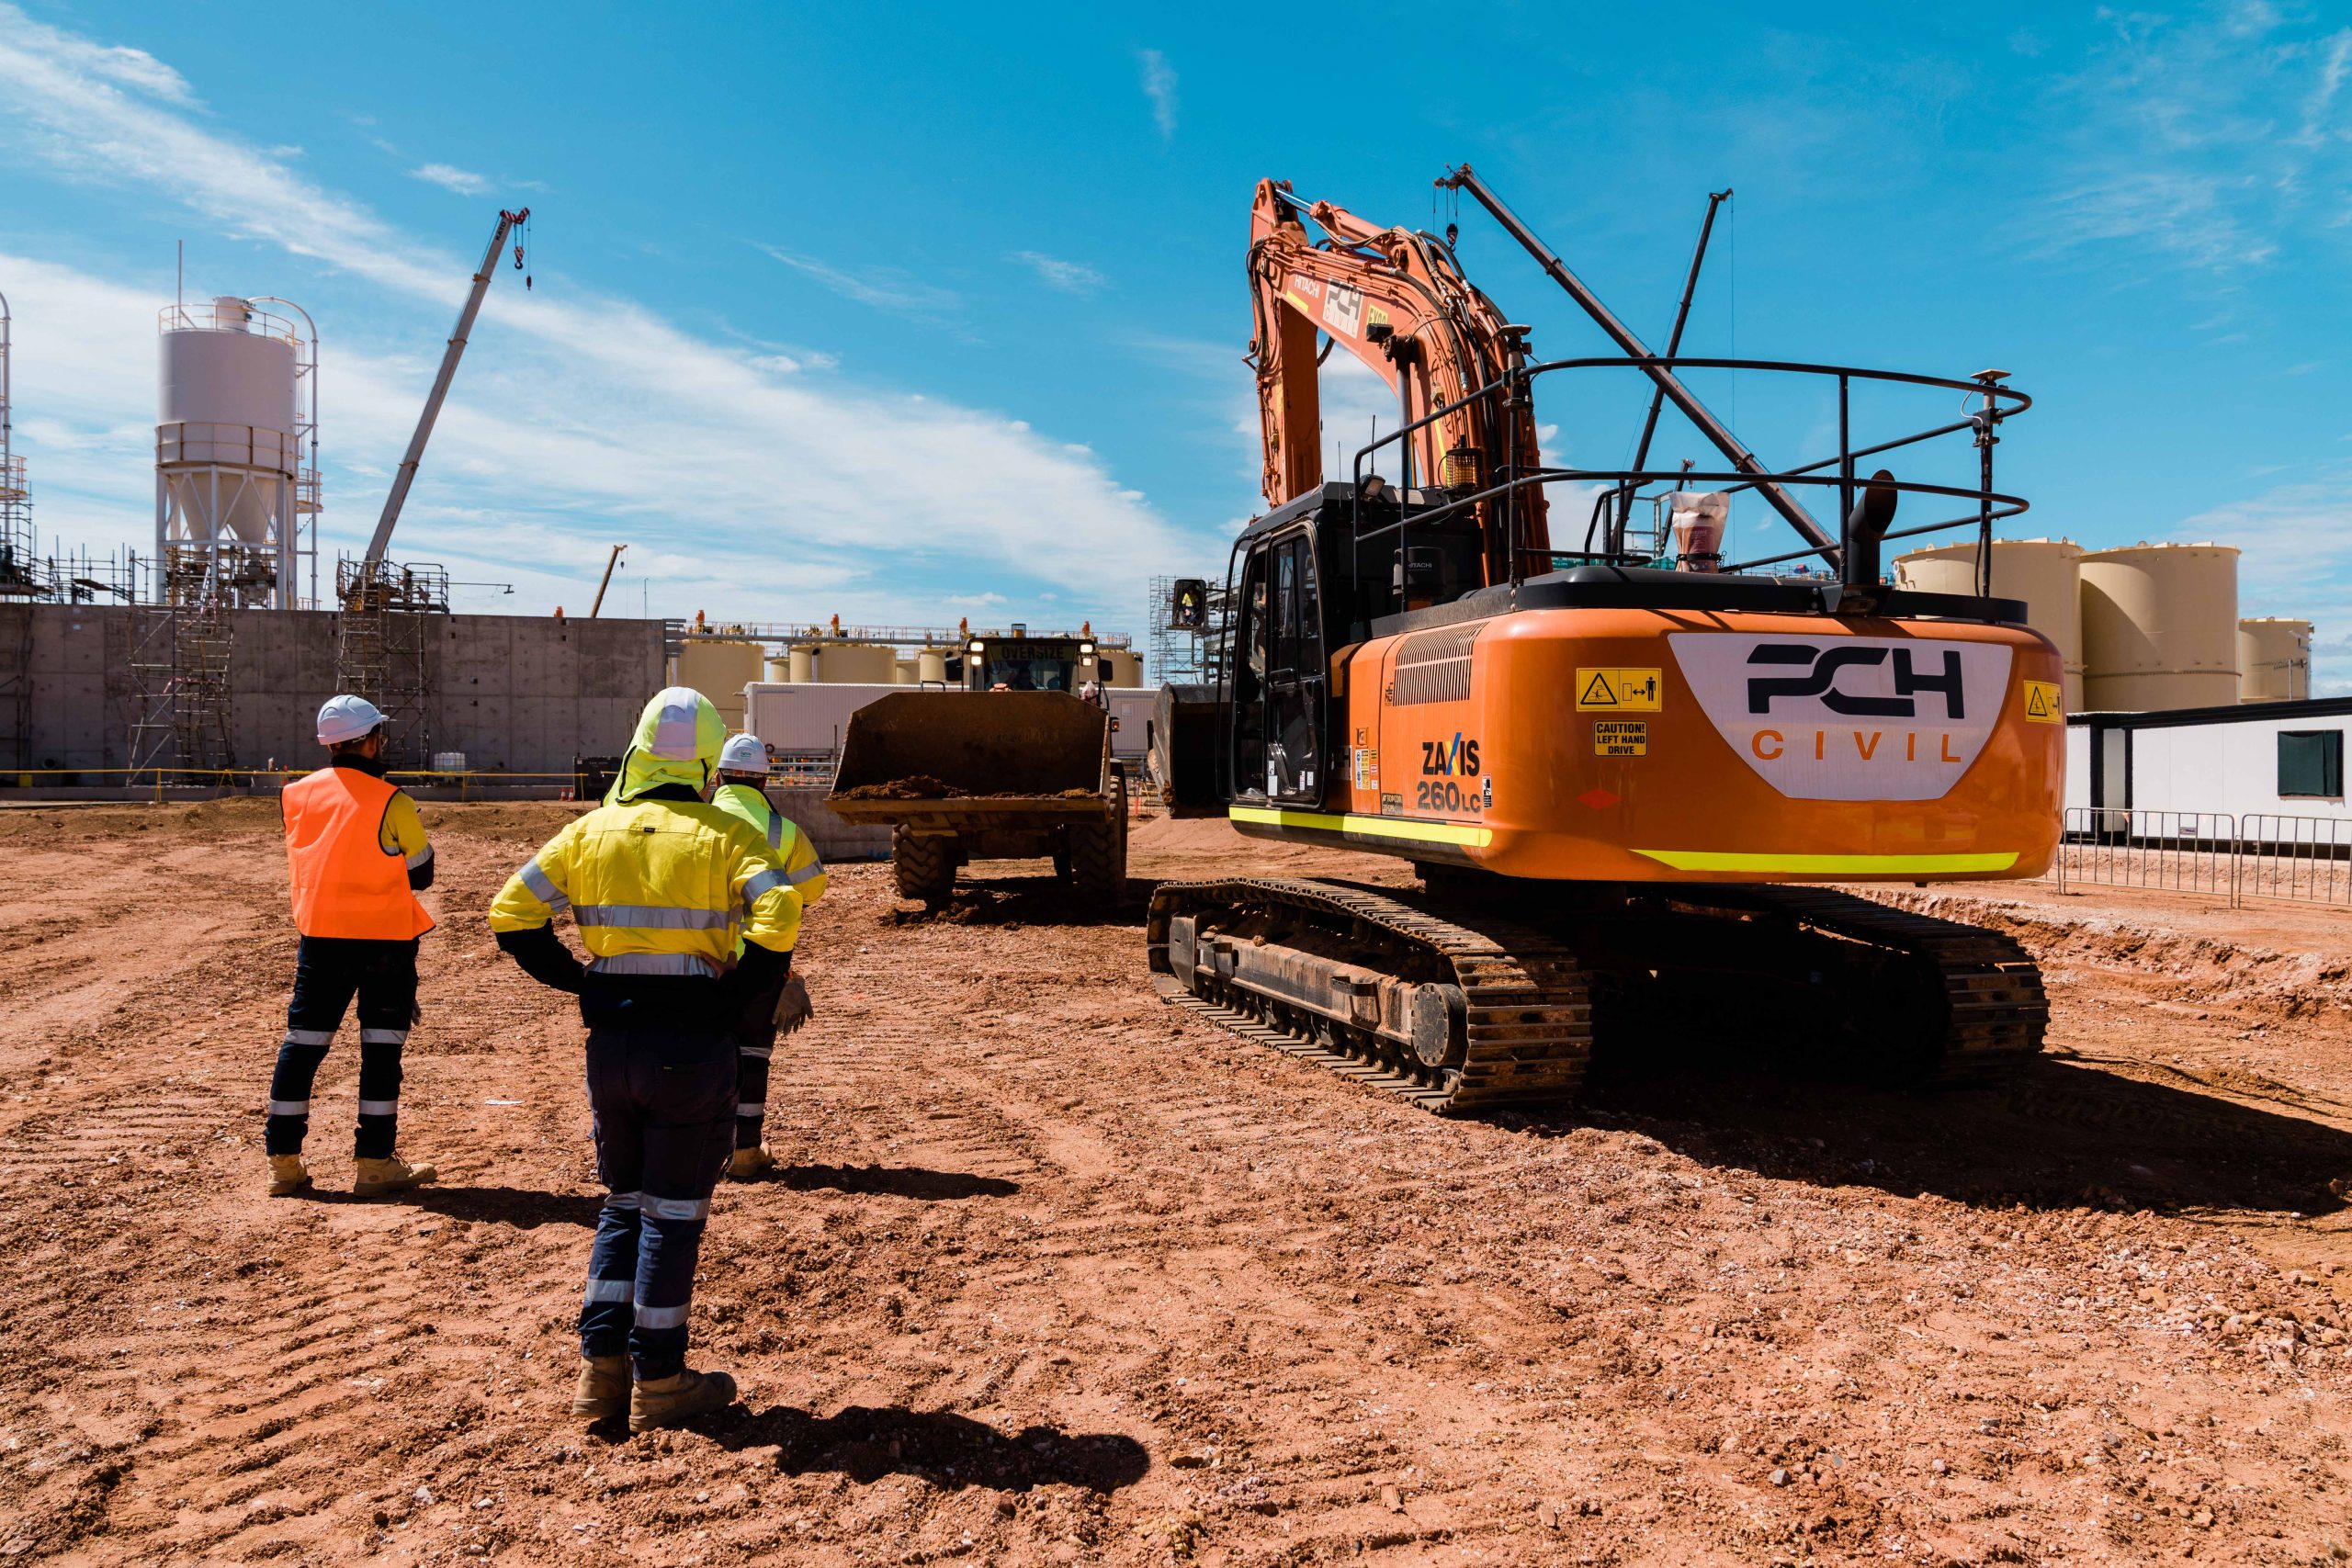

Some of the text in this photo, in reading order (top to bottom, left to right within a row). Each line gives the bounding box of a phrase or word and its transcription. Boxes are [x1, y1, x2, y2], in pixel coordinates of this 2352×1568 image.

[496, 221, 507, 241] KATO
[1295, 275, 1320, 299] HITACHI
[1327, 278, 1363, 321] PCH
[1001, 646, 1064, 660] OVERSIZE
[1747, 643, 1965, 719] PCH
[1596, 723, 1645, 734] CAUTION!
[1597, 736, 1645, 744] LEFT HAND
[1608, 746, 1635, 754] DRIVE
[1751, 729, 1962, 763] CIVIL
[1422, 732, 1480, 777] ZAXIS
